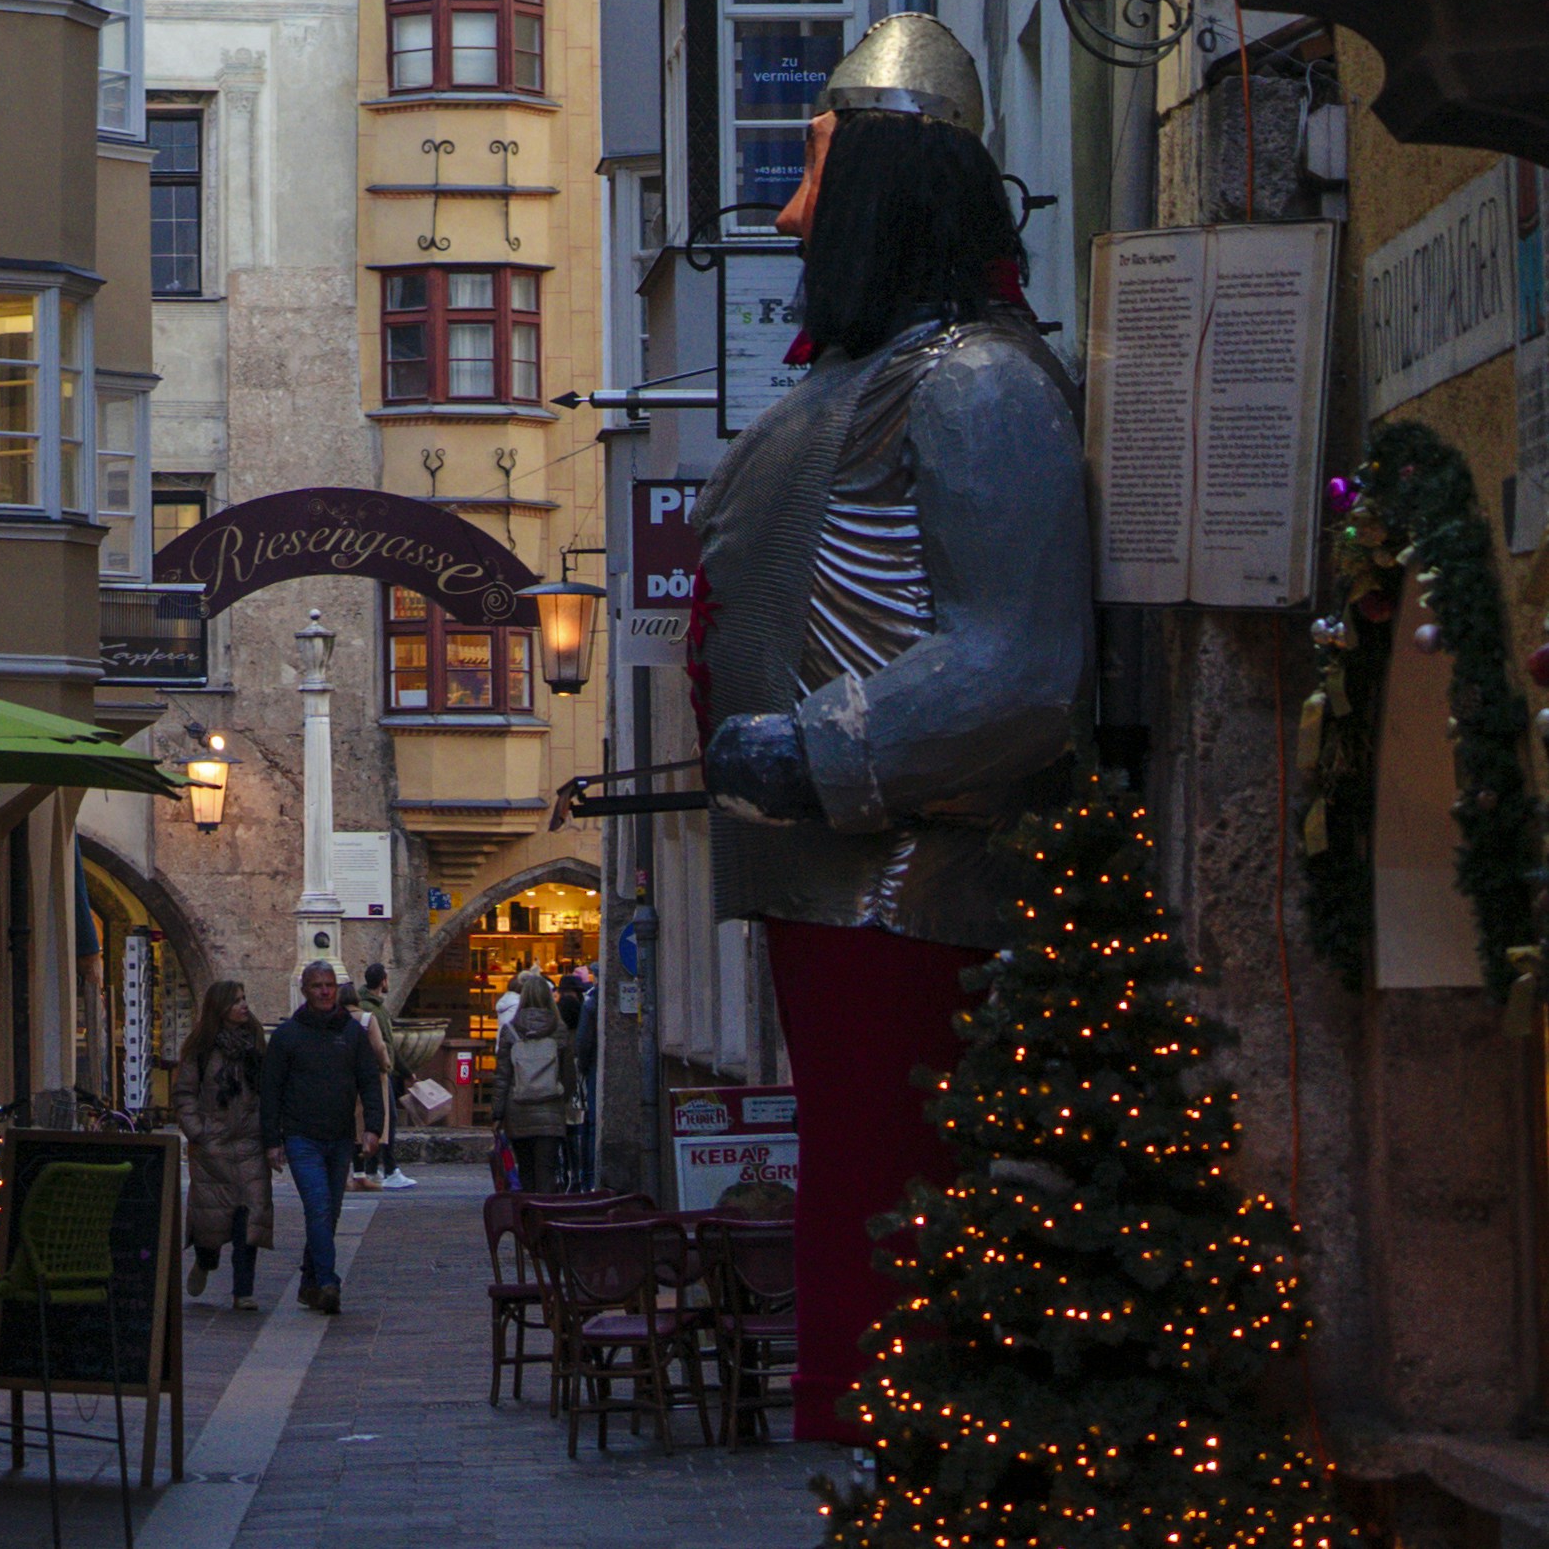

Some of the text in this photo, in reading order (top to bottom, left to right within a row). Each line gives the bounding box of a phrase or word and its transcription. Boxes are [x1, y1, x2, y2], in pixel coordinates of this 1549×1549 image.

[781, 57, 798, 68] zu
[753, 70, 827, 82] vermieten
[189, 519, 497, 603] Riesengasse
[691, 1147, 770, 1165] KEBAP
[740, 1166, 755, 1182] &
